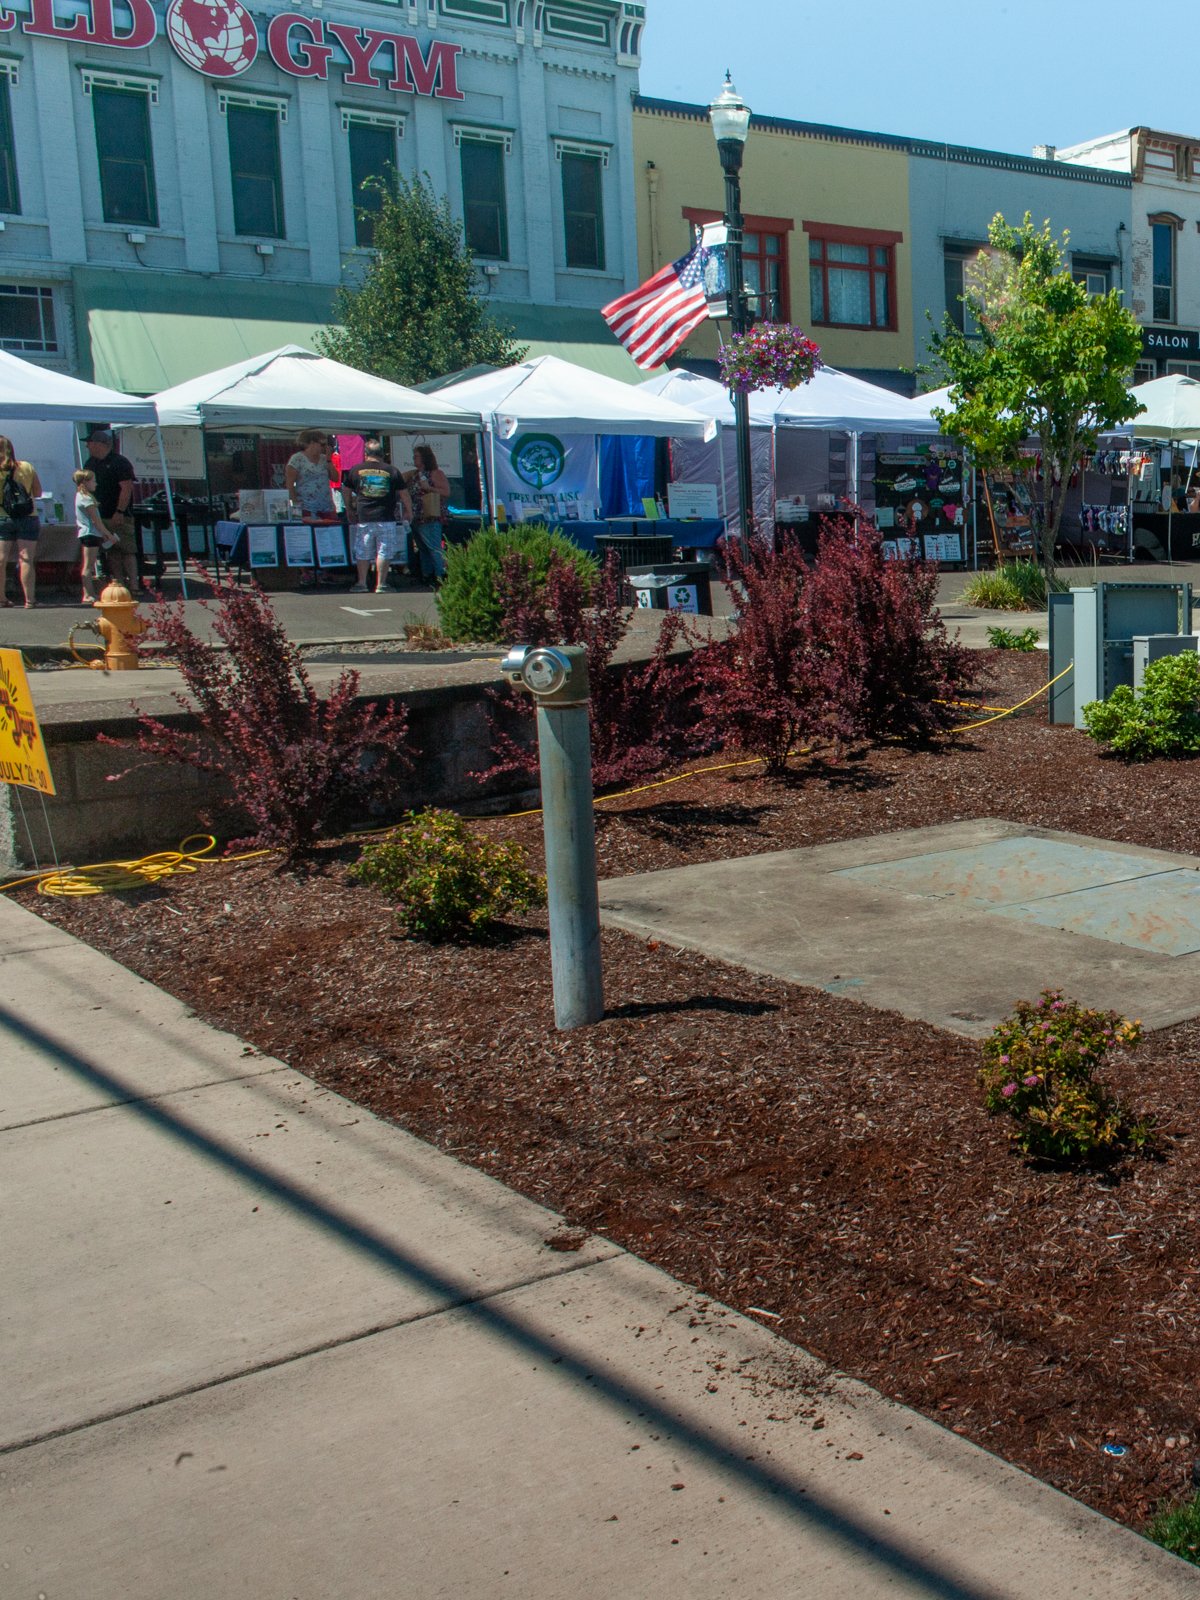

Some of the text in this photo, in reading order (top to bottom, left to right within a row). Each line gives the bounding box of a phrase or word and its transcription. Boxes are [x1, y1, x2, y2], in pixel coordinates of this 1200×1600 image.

[267, 12, 465, 101] GYM
[1148, 334, 1189, 348] SALON
[507, 492, 530, 503] TREE
